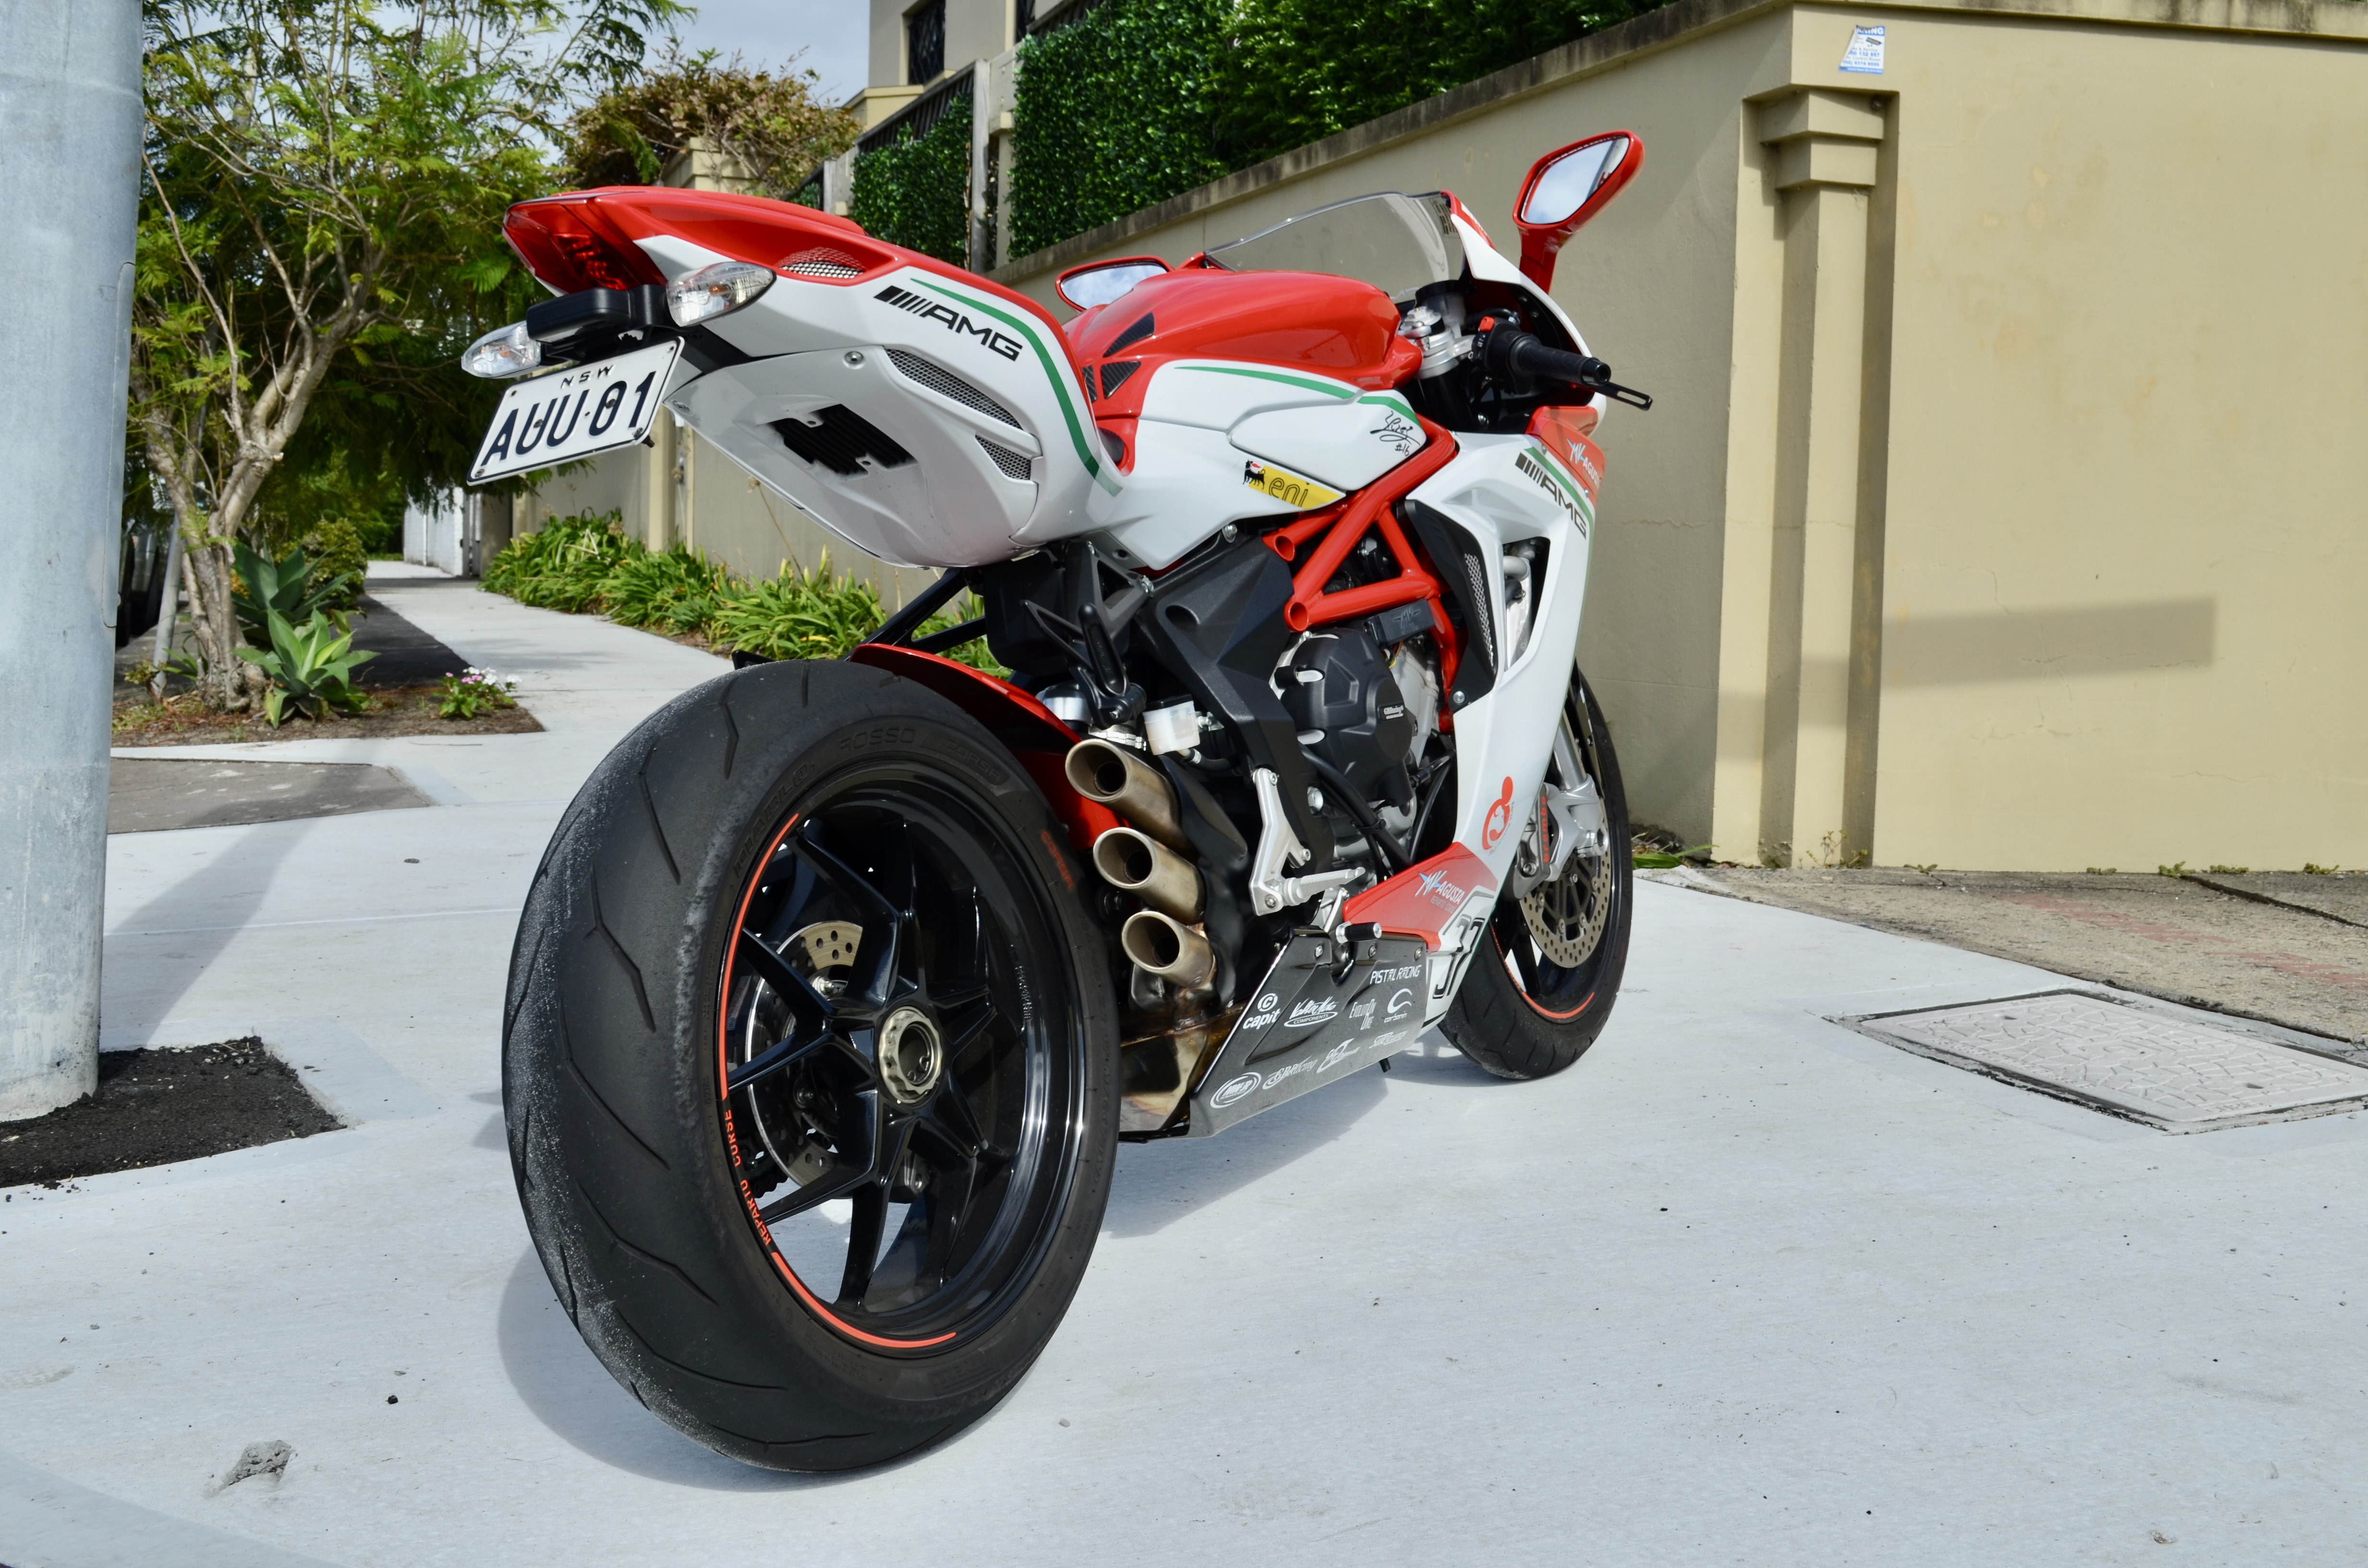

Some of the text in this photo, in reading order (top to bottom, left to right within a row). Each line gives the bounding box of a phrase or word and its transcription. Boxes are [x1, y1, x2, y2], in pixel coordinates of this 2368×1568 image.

[919, 303, 1023, 362] AMG
[560, 365, 614, 388] NSW
[1268, 477, 1310, 508] eni
[1540, 474, 1586, 539] AMG
[1540, 796, 1550, 863] brembo
[1435, 881, 1466, 904] AGUSTA
[1243, 1008, 1282, 1029] capit
[1293, 1014, 1329, 1024] COMPONENTS
[724, 1109, 742, 1167] CORSE
